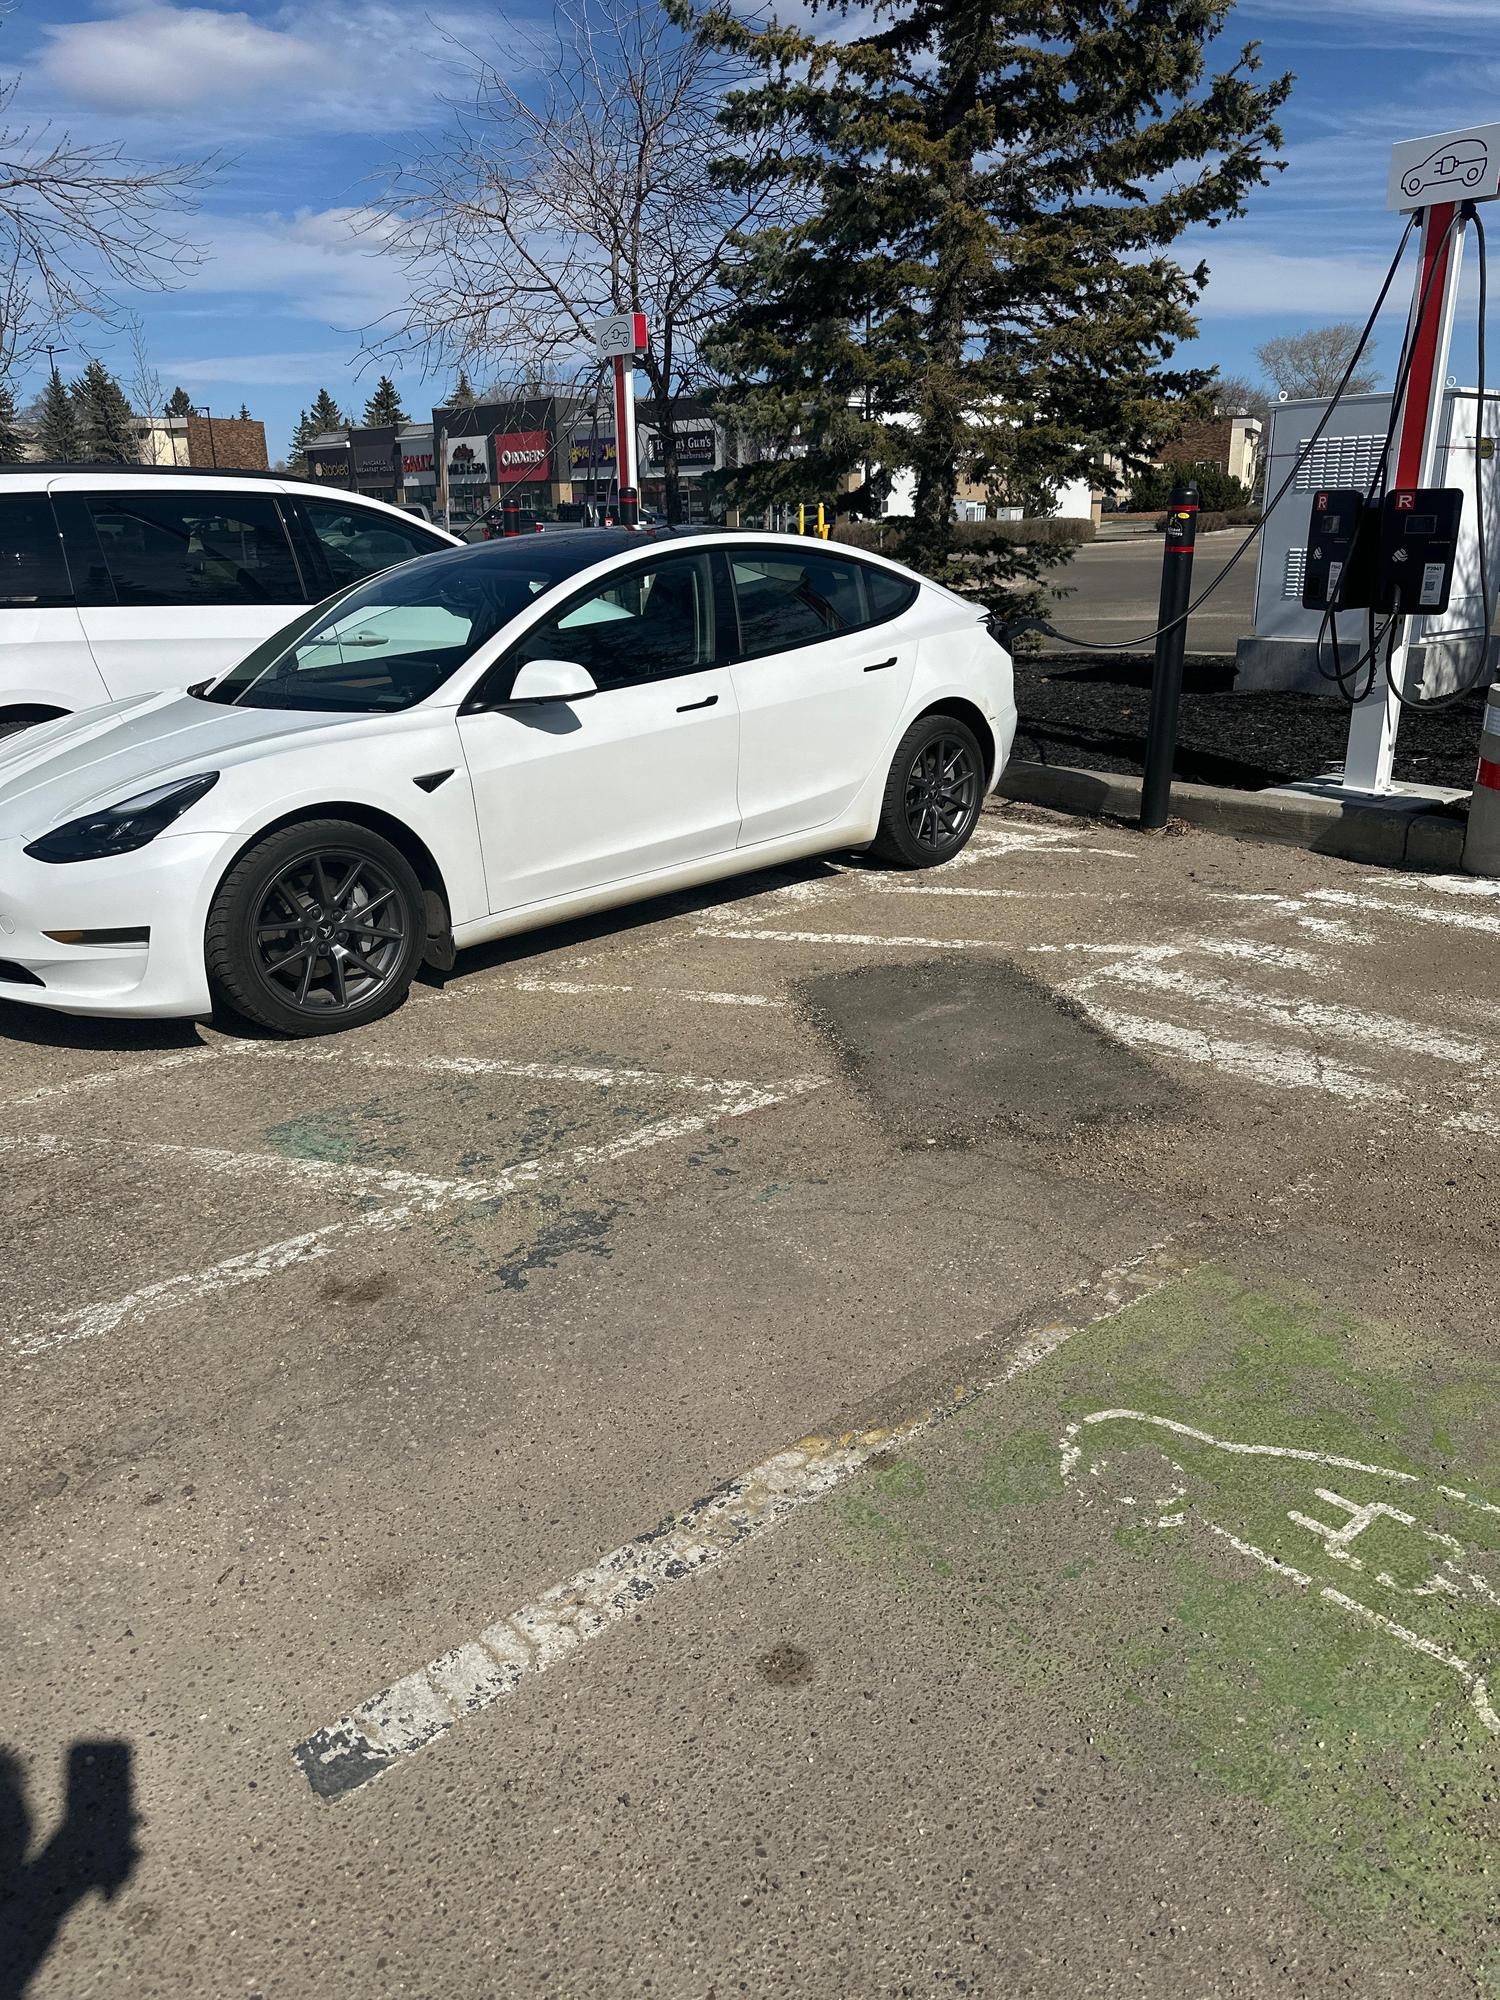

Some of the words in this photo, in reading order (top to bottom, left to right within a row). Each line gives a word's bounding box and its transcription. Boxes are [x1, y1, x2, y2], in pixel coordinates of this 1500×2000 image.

[687, 435, 711, 448] Gun's
[511, 449, 545, 463] ROGERS
[402, 454, 433, 472] SALLY
[472, 462, 487, 474] SPA
[1318, 496, 1327, 508] R
[1397, 495, 1413, 508] R
